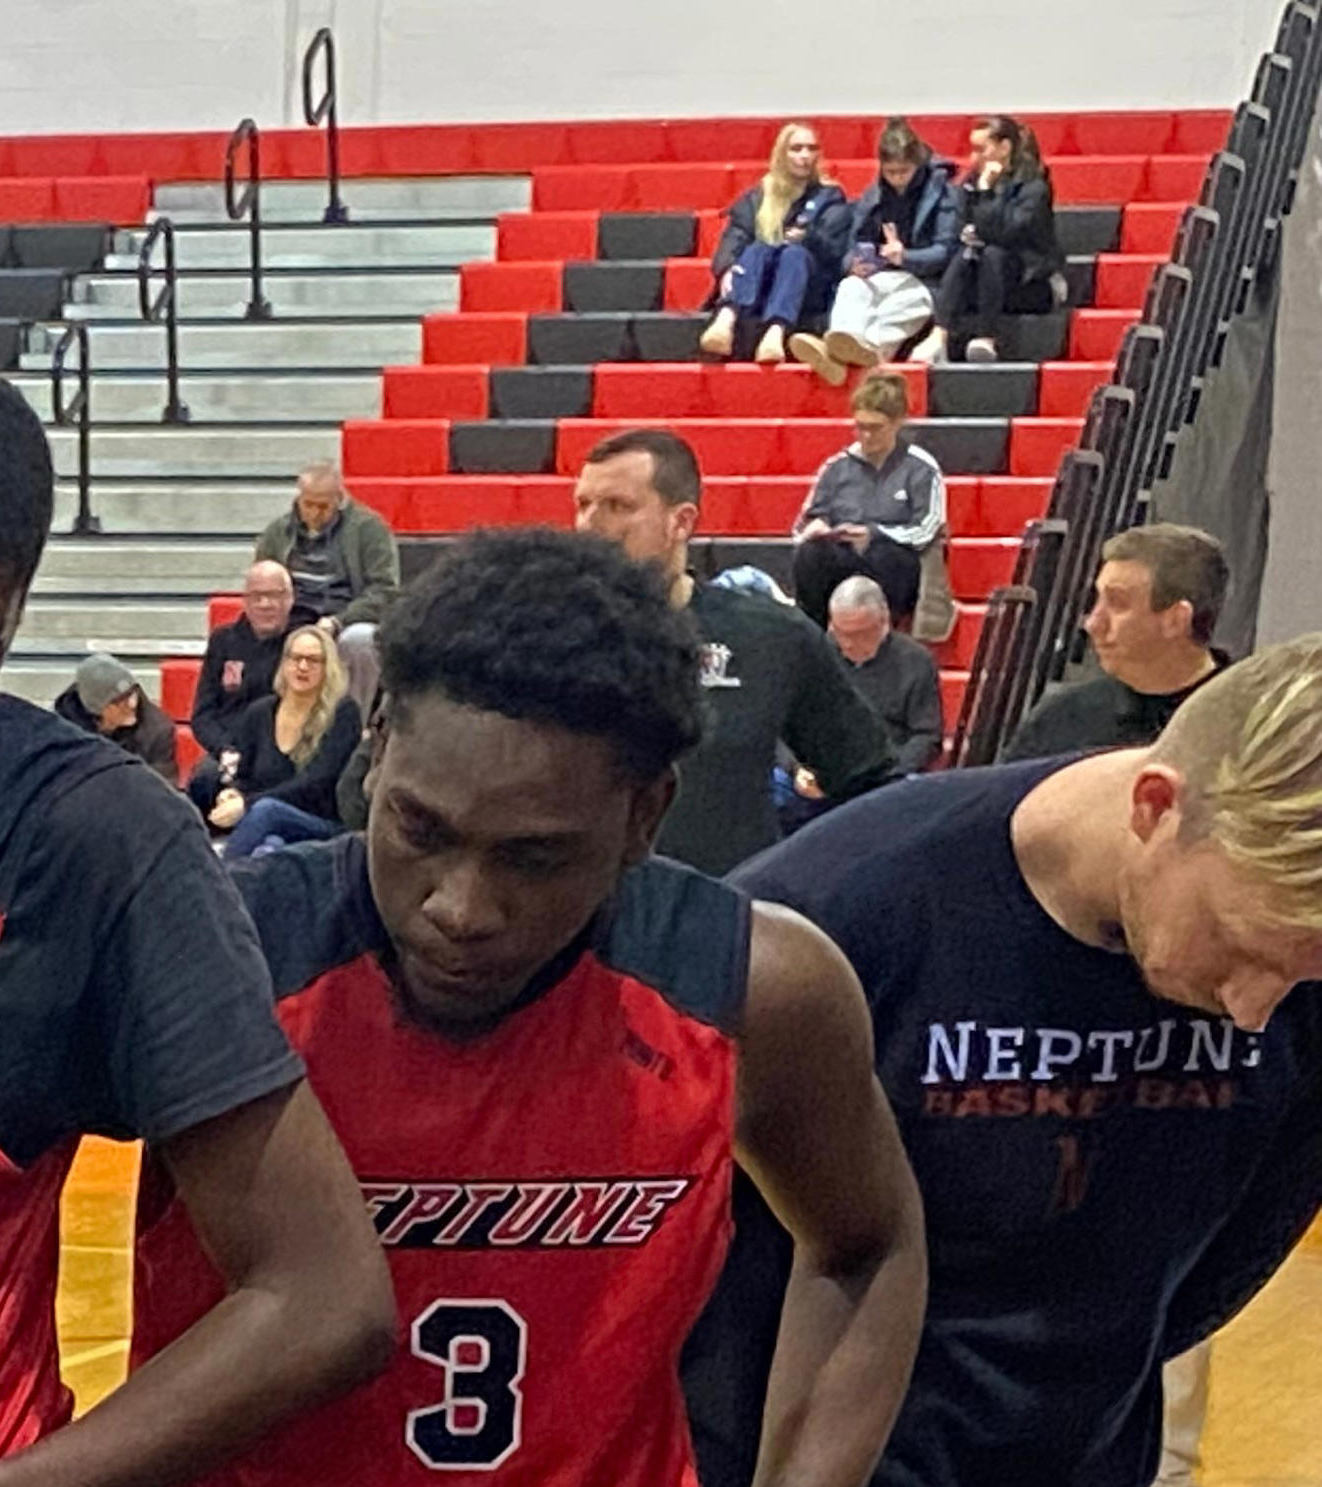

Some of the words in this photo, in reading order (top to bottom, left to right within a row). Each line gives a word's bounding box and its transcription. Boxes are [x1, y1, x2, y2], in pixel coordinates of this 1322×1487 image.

[920, 1017, 1264, 1085] NEPTUN
[359, 1180, 688, 1245] EPTUNE
[405, 1299, 528, 1471] 3
